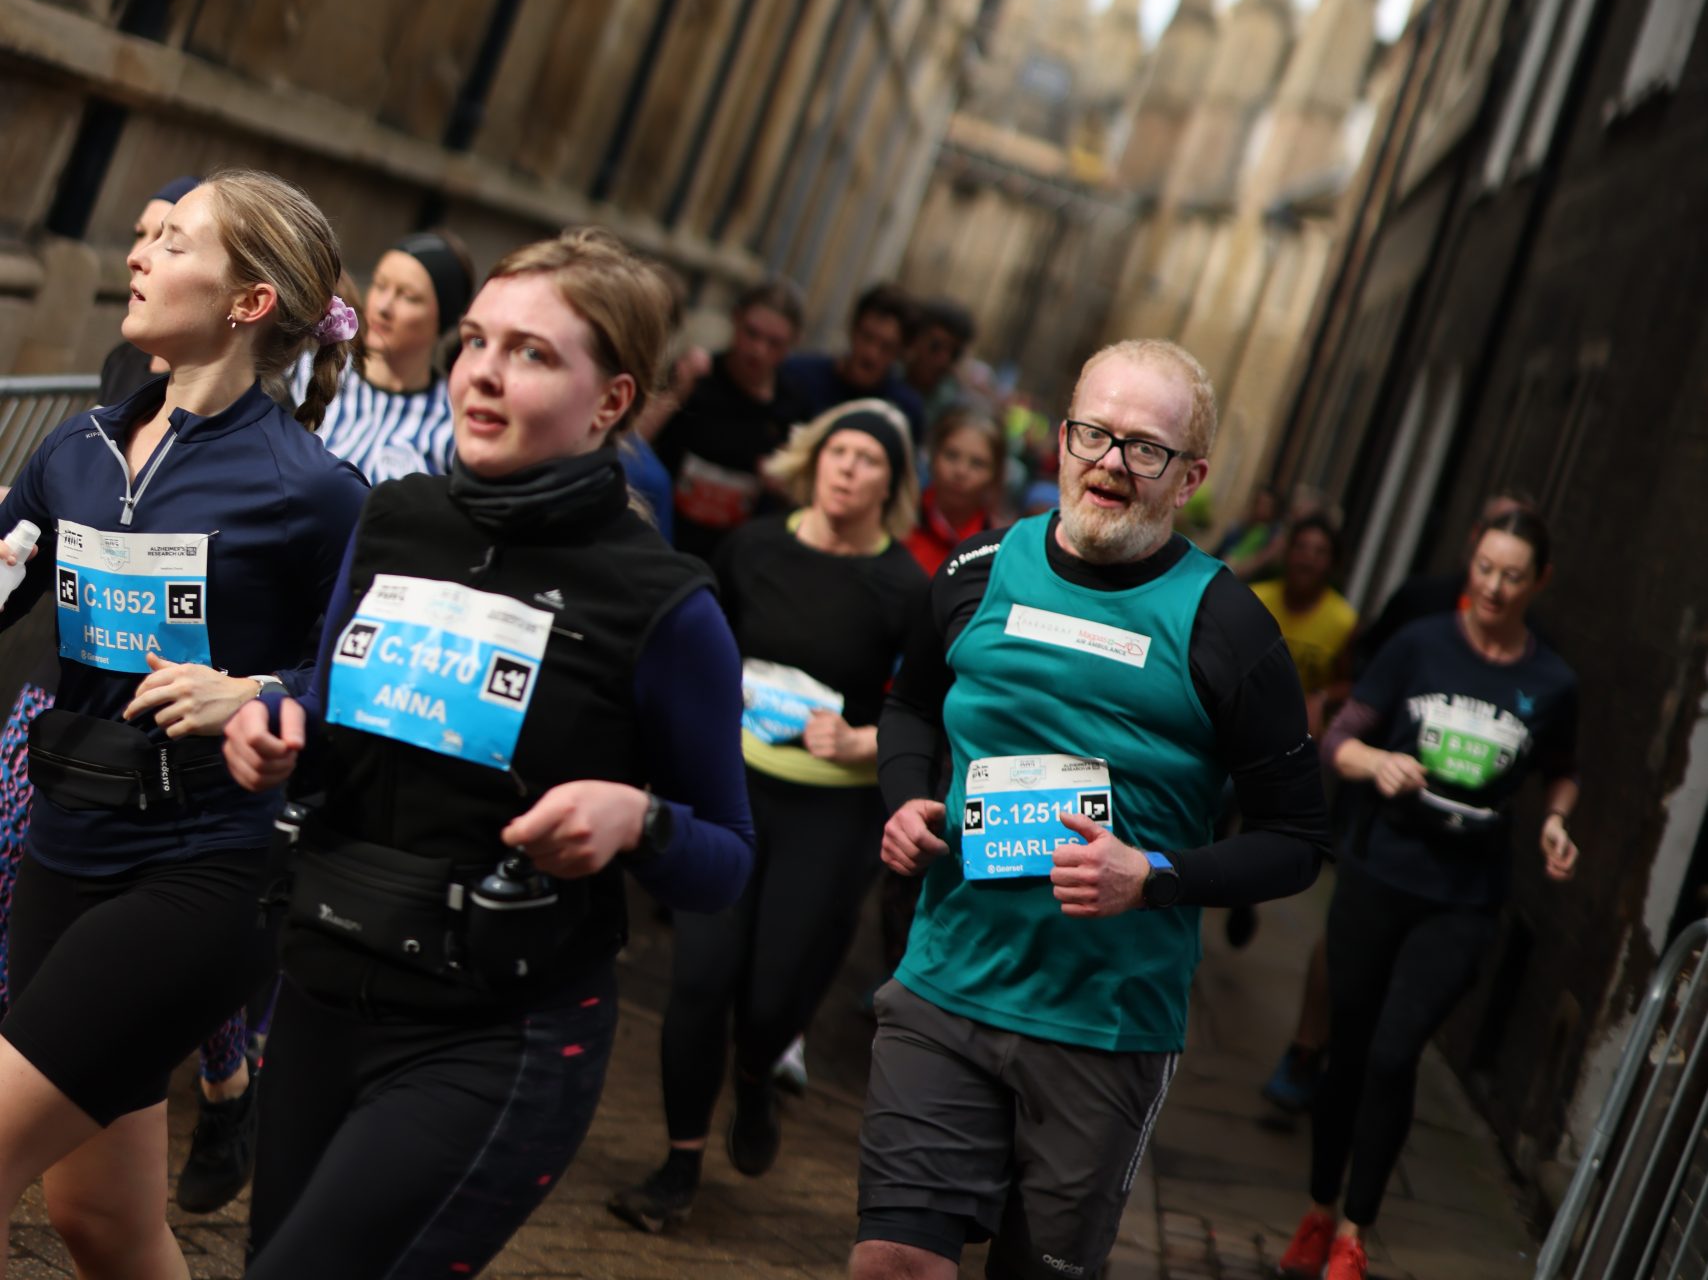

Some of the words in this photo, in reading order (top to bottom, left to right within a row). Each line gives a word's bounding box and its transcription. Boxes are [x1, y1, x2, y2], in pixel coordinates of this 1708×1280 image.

[83, 583, 156, 615] C.1952
[83, 624, 162, 652] HELENA
[379, 635, 478, 685] C.1470
[373, 684, 448, 725] ANNA
